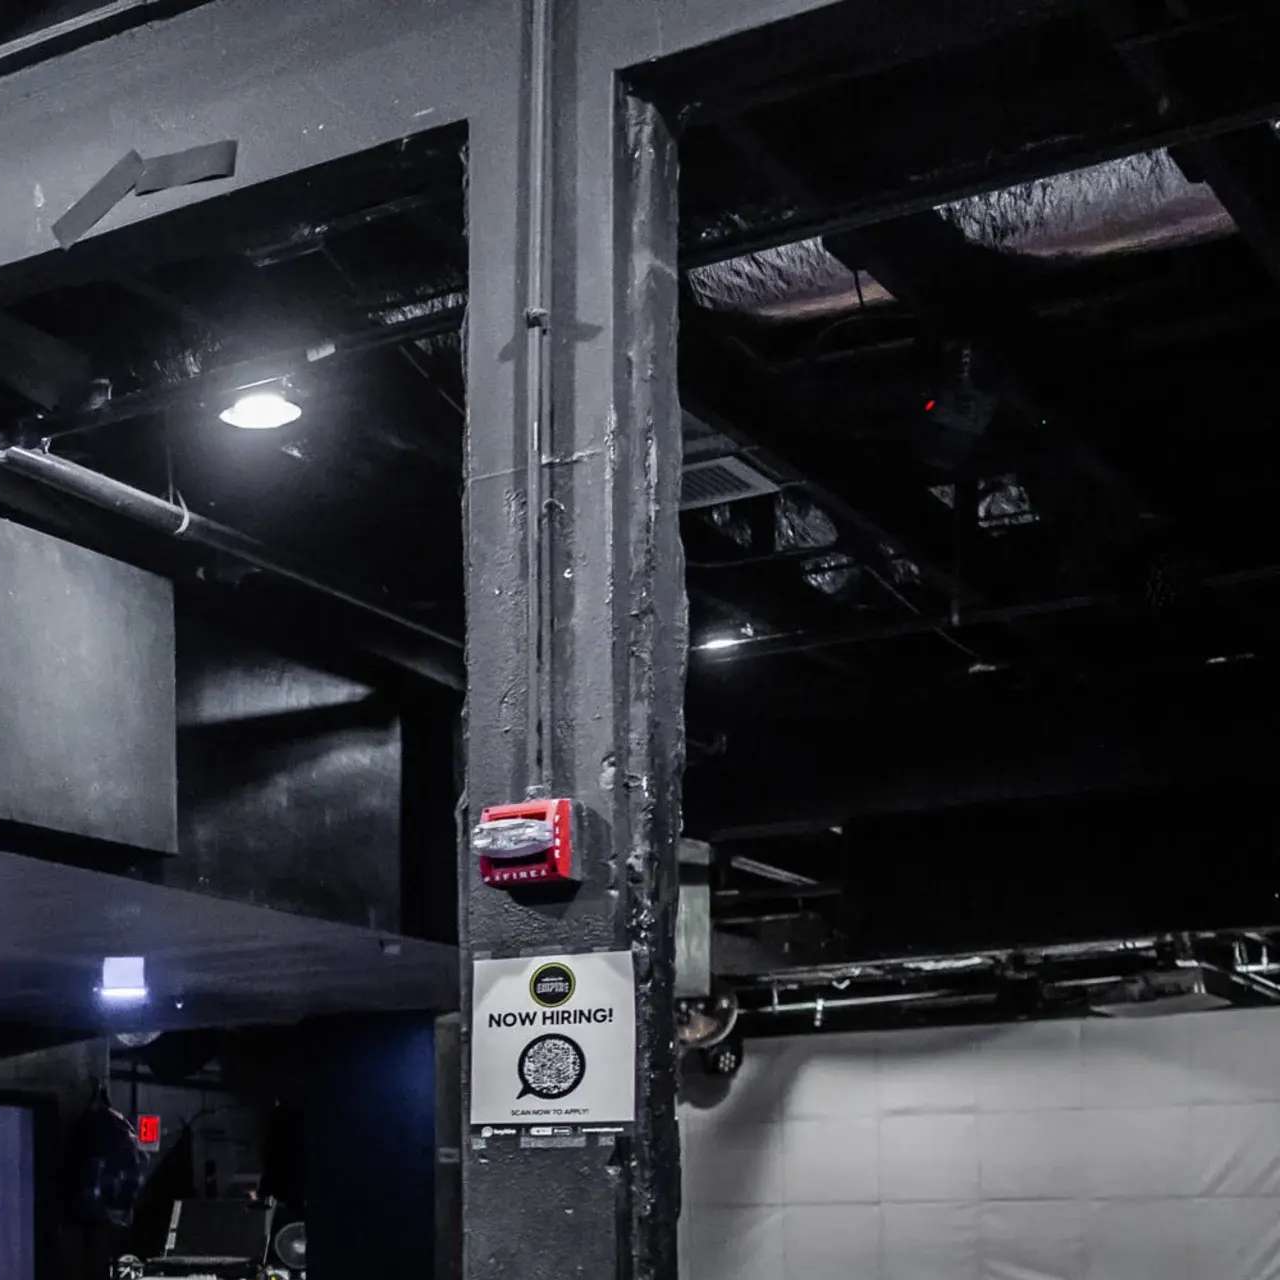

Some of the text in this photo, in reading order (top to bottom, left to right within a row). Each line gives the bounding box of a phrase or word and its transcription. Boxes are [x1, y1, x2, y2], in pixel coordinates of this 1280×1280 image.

[502, 869, 537, 880] FIRE
[488, 1007, 613, 1028] NOW HIRING!
[511, 1109, 531, 1117] SCAN
